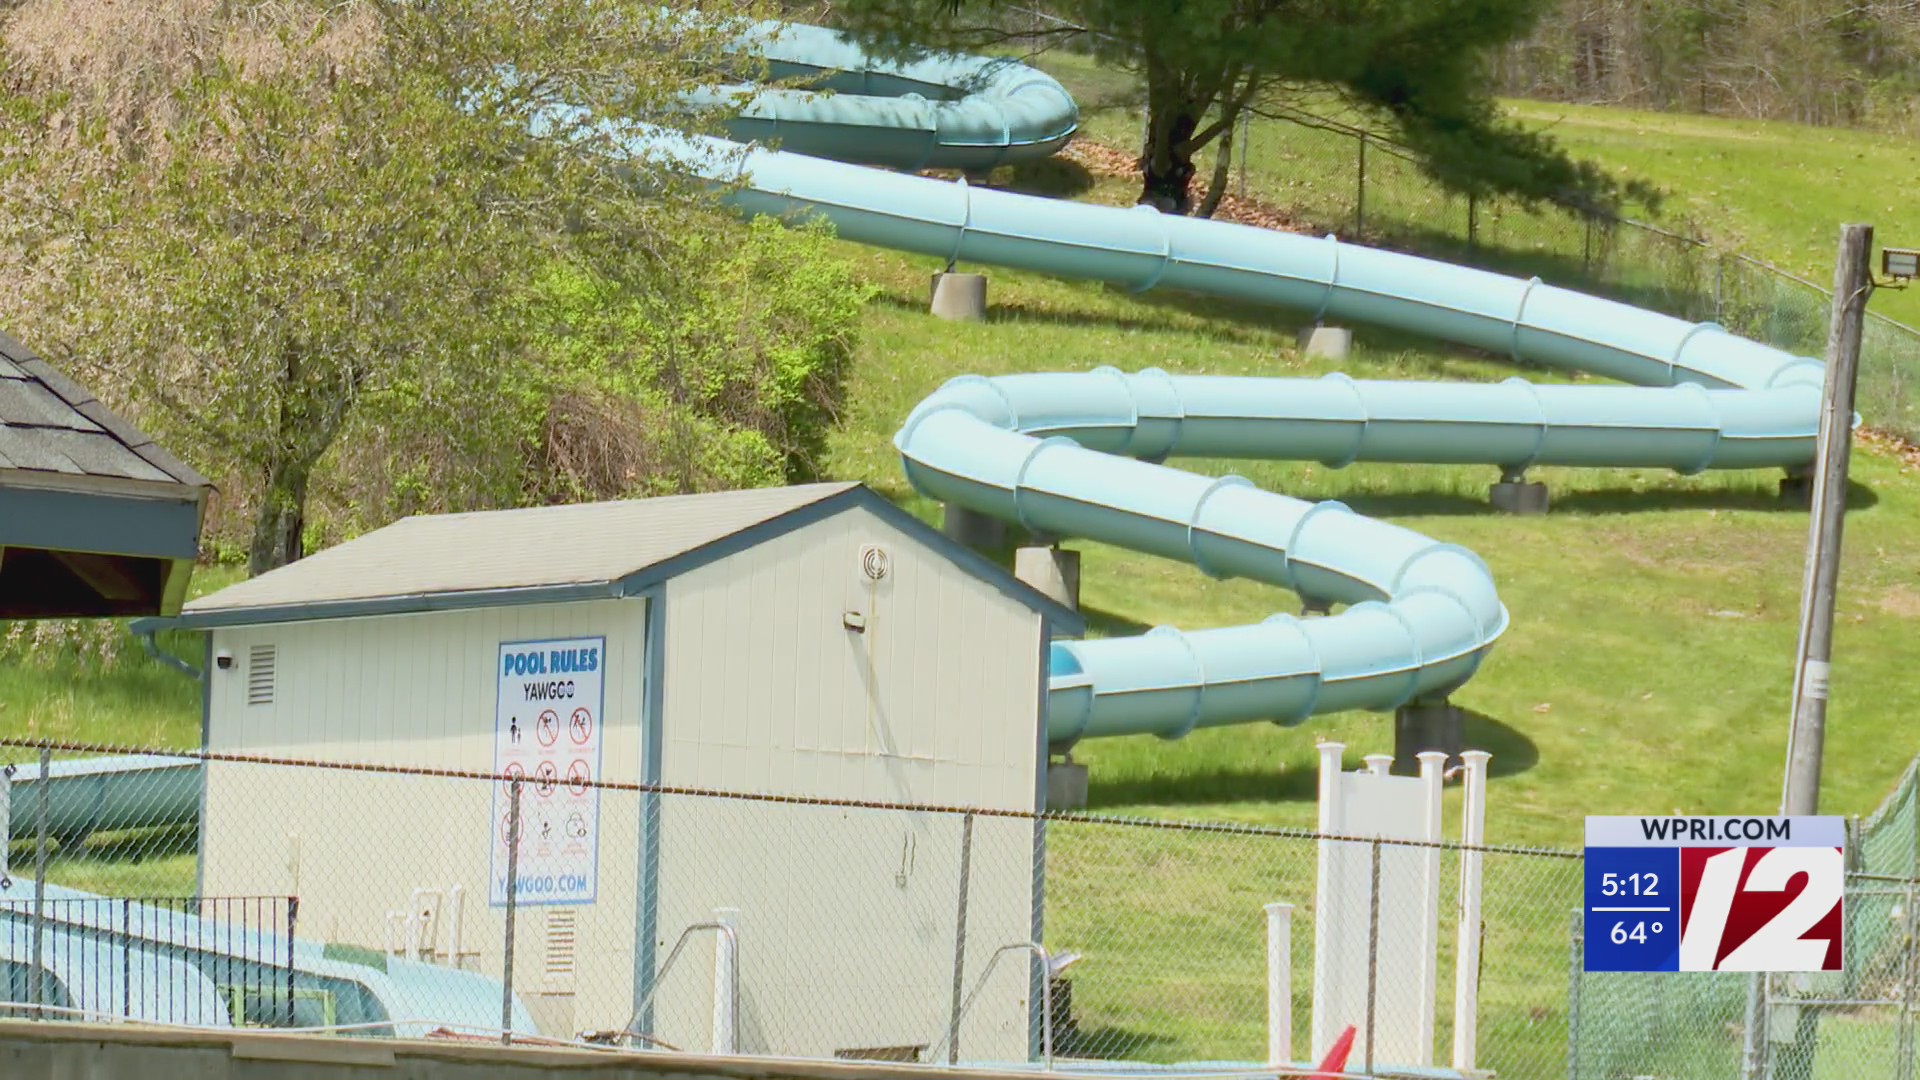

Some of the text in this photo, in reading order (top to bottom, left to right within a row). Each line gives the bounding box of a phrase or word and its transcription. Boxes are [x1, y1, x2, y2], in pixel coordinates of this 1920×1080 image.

[505, 648, 598, 676] POOL RULES
[524, 680, 575, 701] YAWGOO
[499, 874, 587, 894] YWGOO.COM
